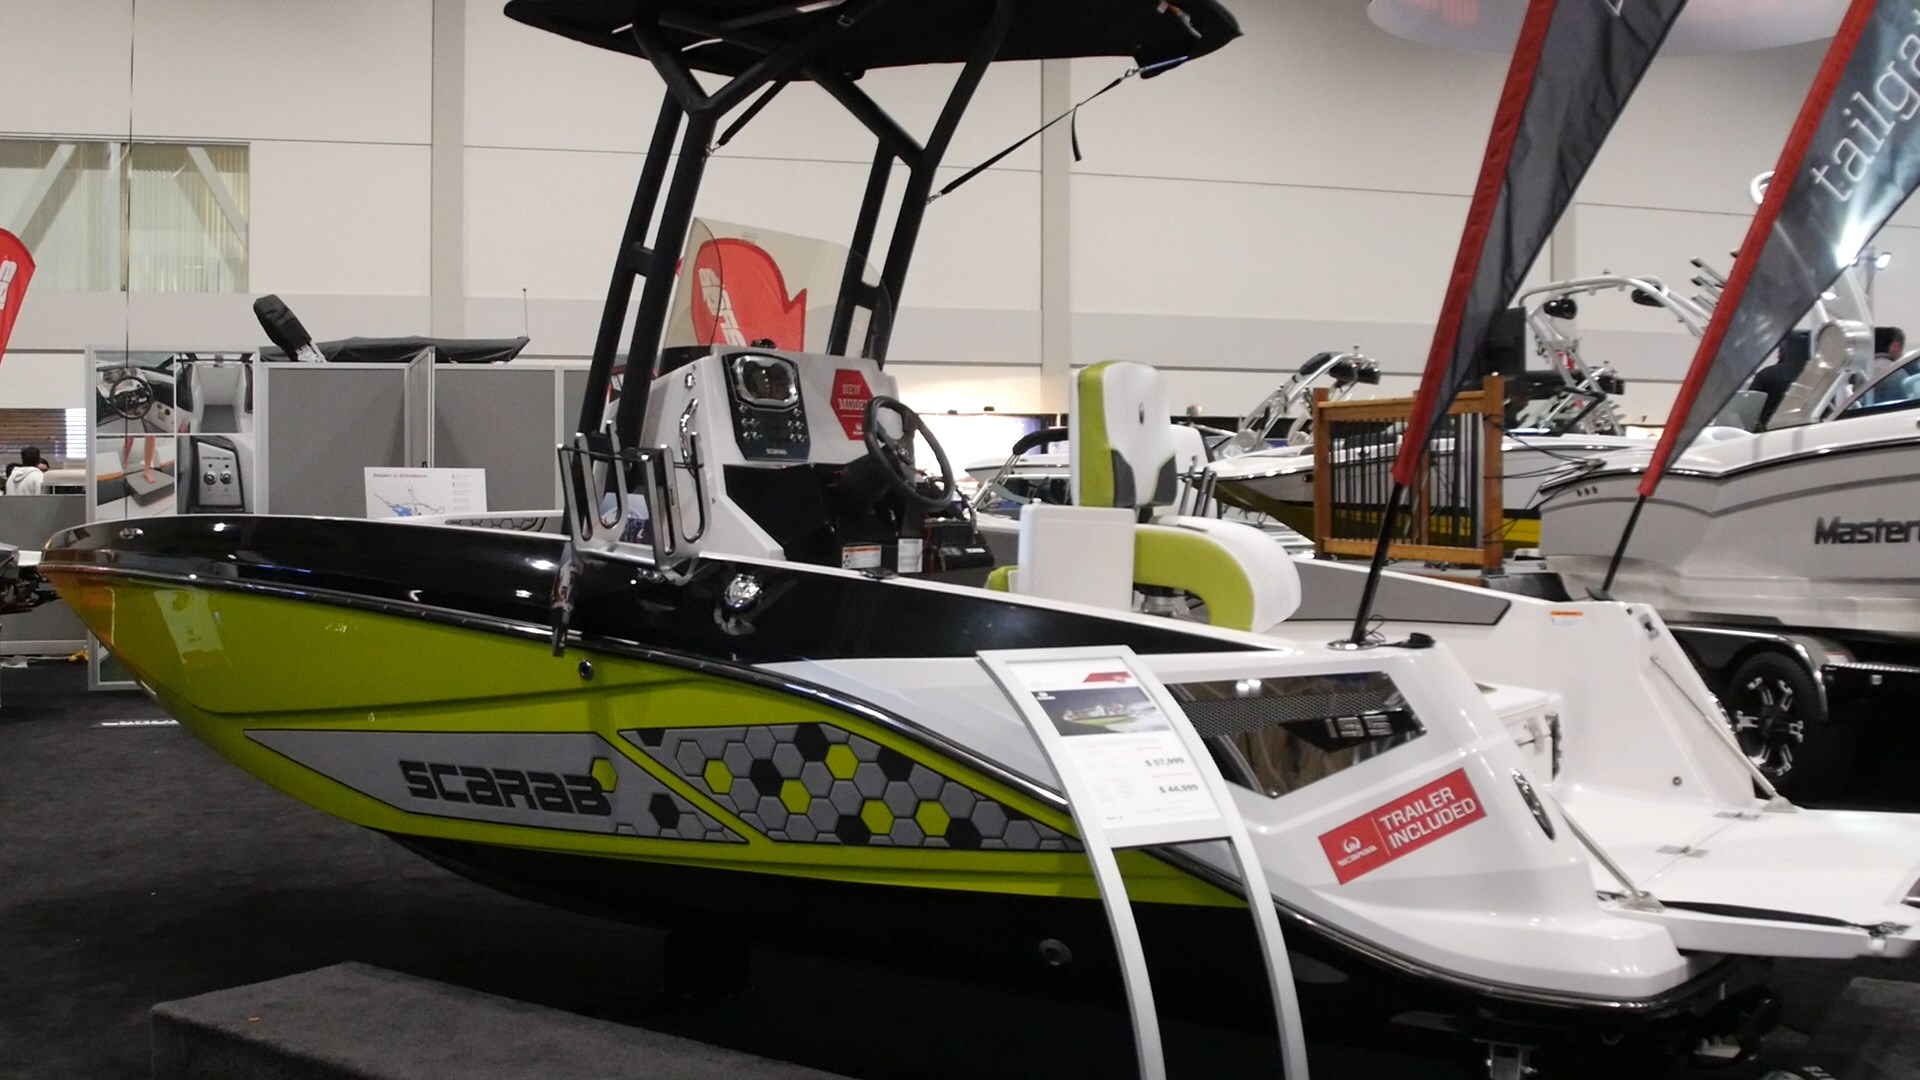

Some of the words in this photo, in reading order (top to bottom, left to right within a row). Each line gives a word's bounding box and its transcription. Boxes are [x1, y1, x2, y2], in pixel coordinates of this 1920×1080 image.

[1814, 516, 1920, 545] Master
[399, 760, 612, 817] SCARAB
[1379, 786, 1455, 832] TRAILER
[1388, 797, 1476, 850] INCLUDED
